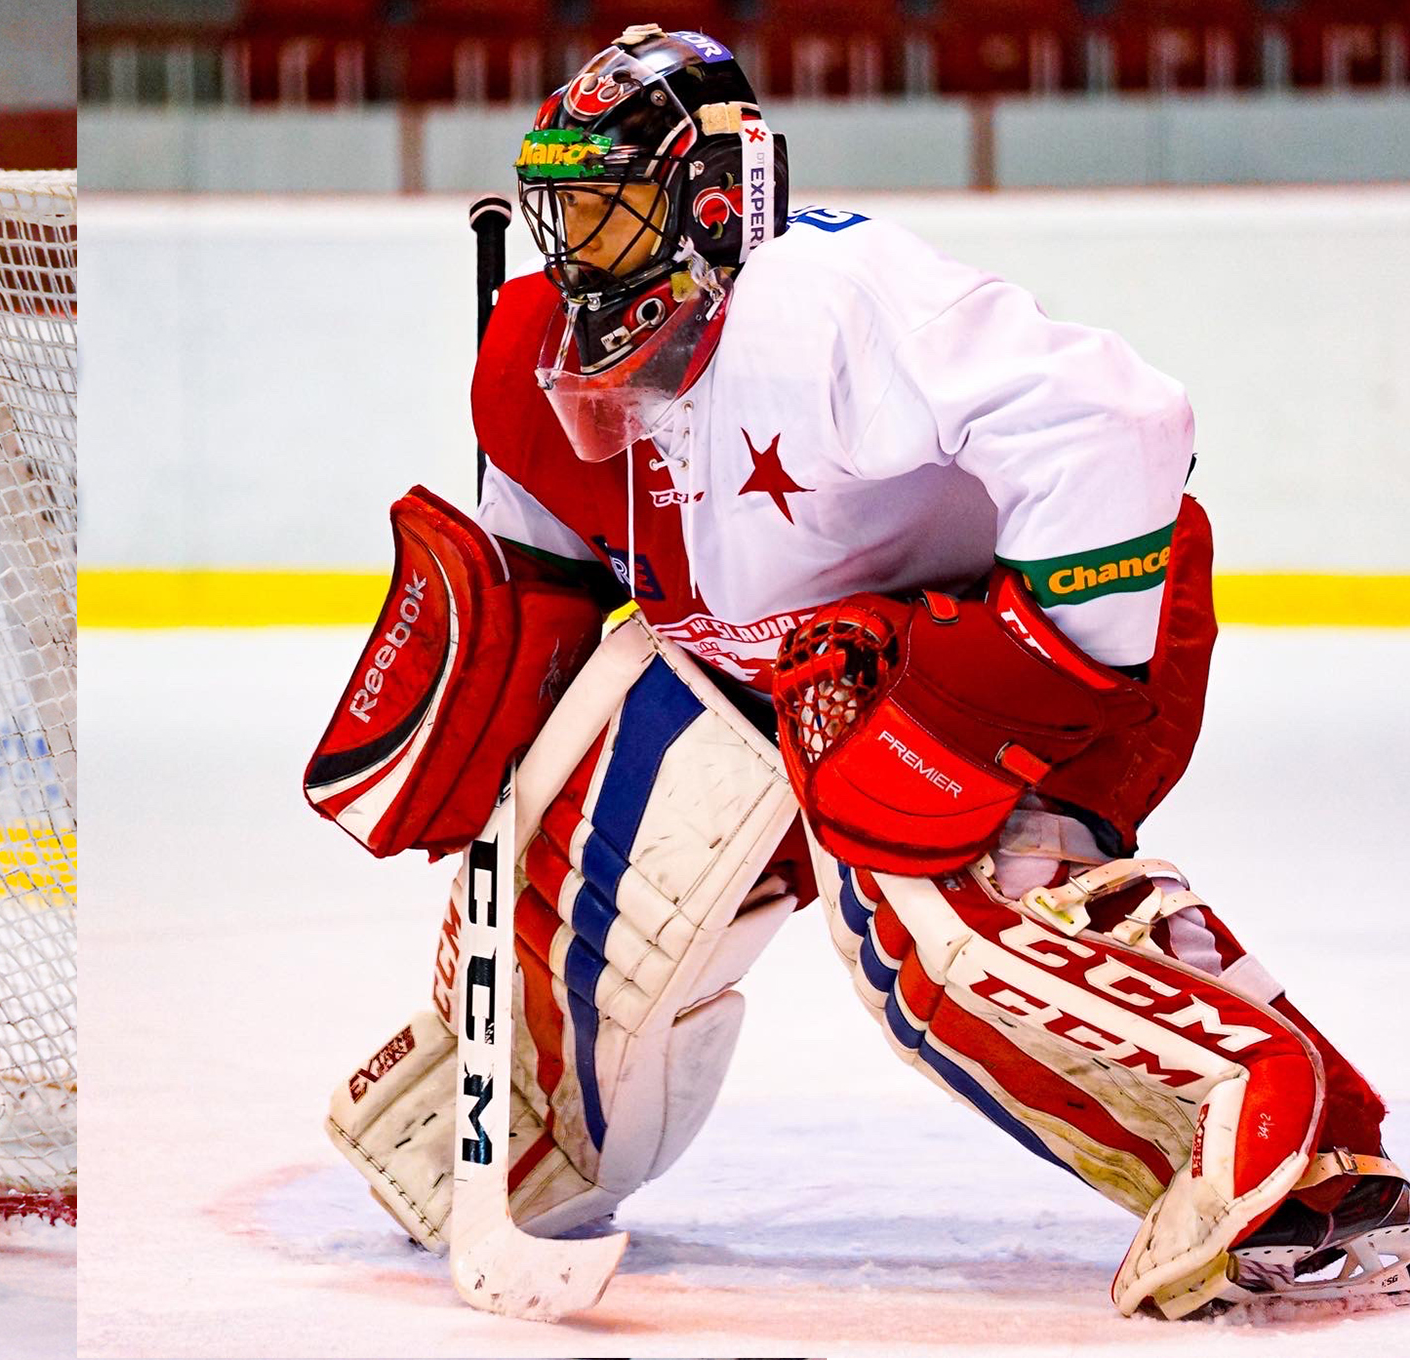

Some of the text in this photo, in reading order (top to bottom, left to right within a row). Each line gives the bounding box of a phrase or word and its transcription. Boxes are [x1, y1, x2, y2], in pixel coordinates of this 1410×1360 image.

[714, 615, 797, 642] SLAVIA
[1048, 546, 1170, 595] Chance
[349, 568, 427, 724] Reebok
[877, 730, 963, 799] PREMIER
[433, 896, 462, 1023] CCM
[462, 833, 499, 1166] CCM
[999, 914, 1273, 1052] CCM
[969, 970, 1205, 1088] CCM
